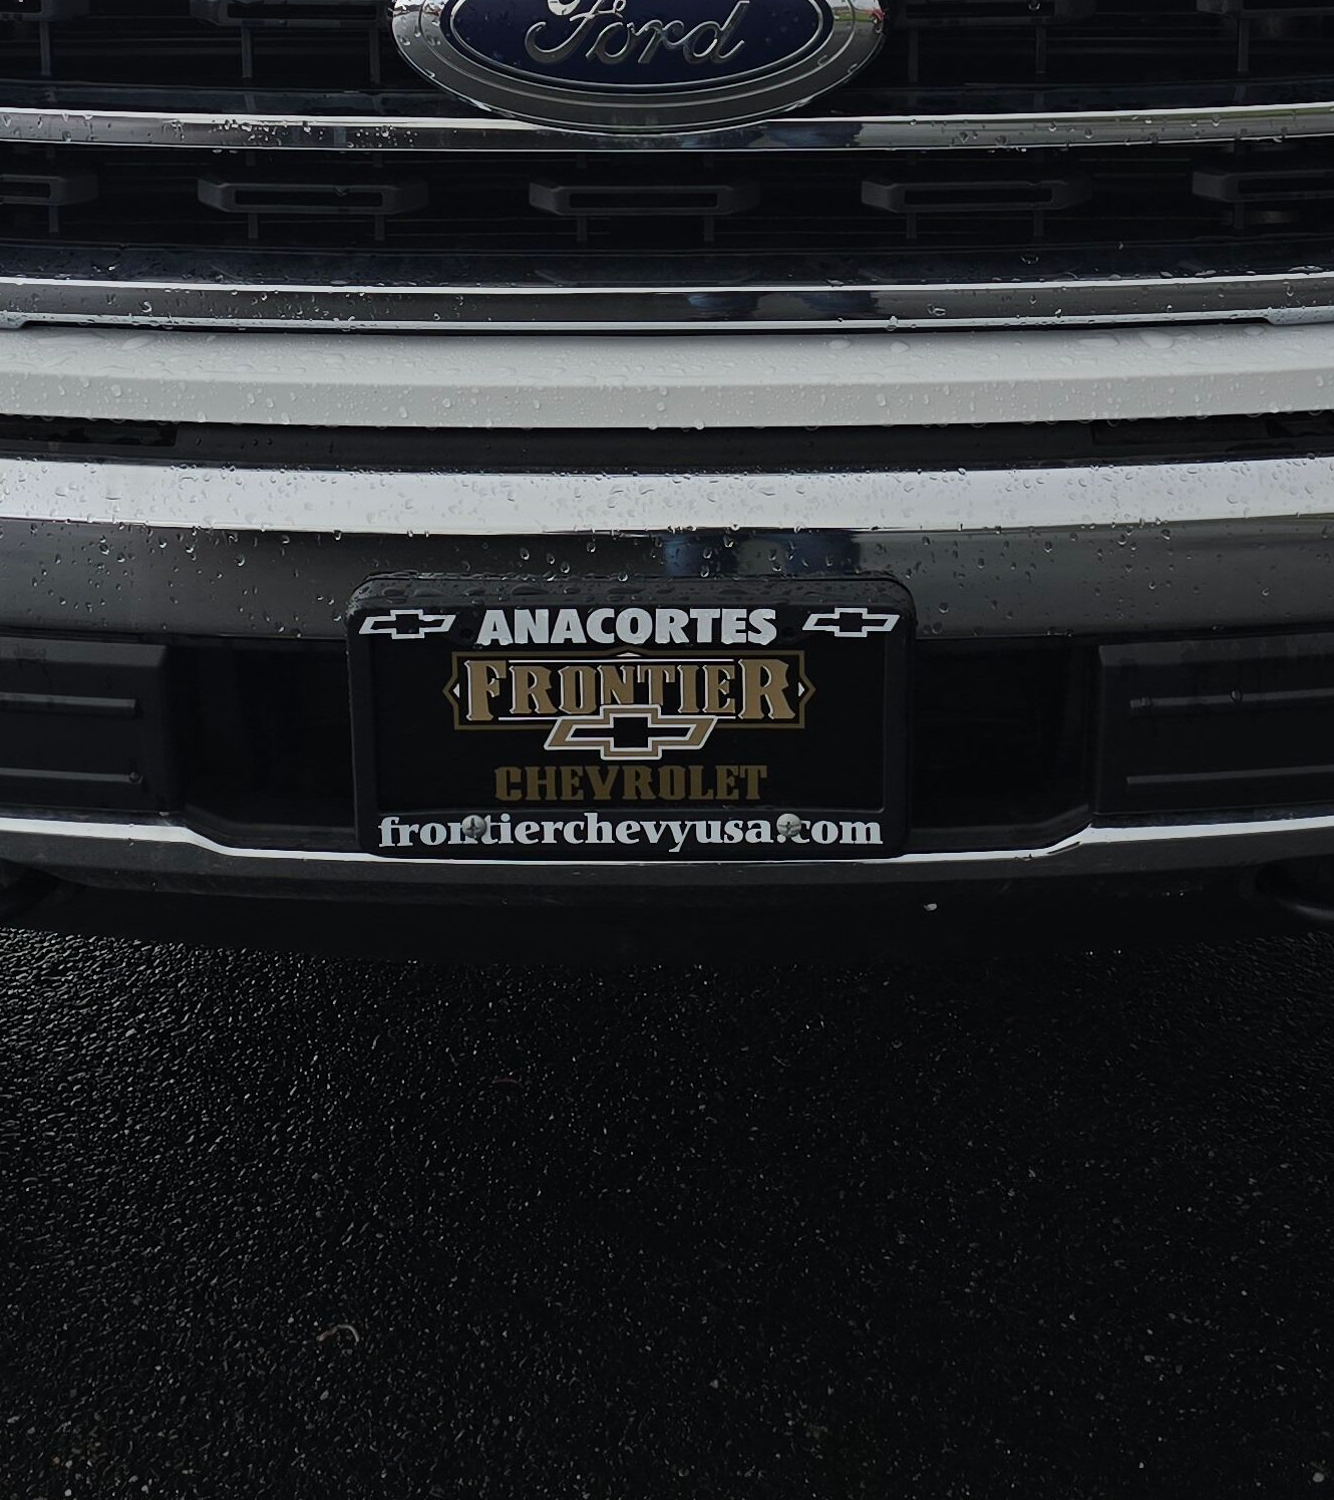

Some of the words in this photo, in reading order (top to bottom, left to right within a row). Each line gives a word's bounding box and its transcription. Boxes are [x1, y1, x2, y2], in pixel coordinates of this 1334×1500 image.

[475, 608, 777, 645] ANACORTES
[464, 657, 796, 723] FRONTIER
[494, 764, 767, 801] CHEVROLET
